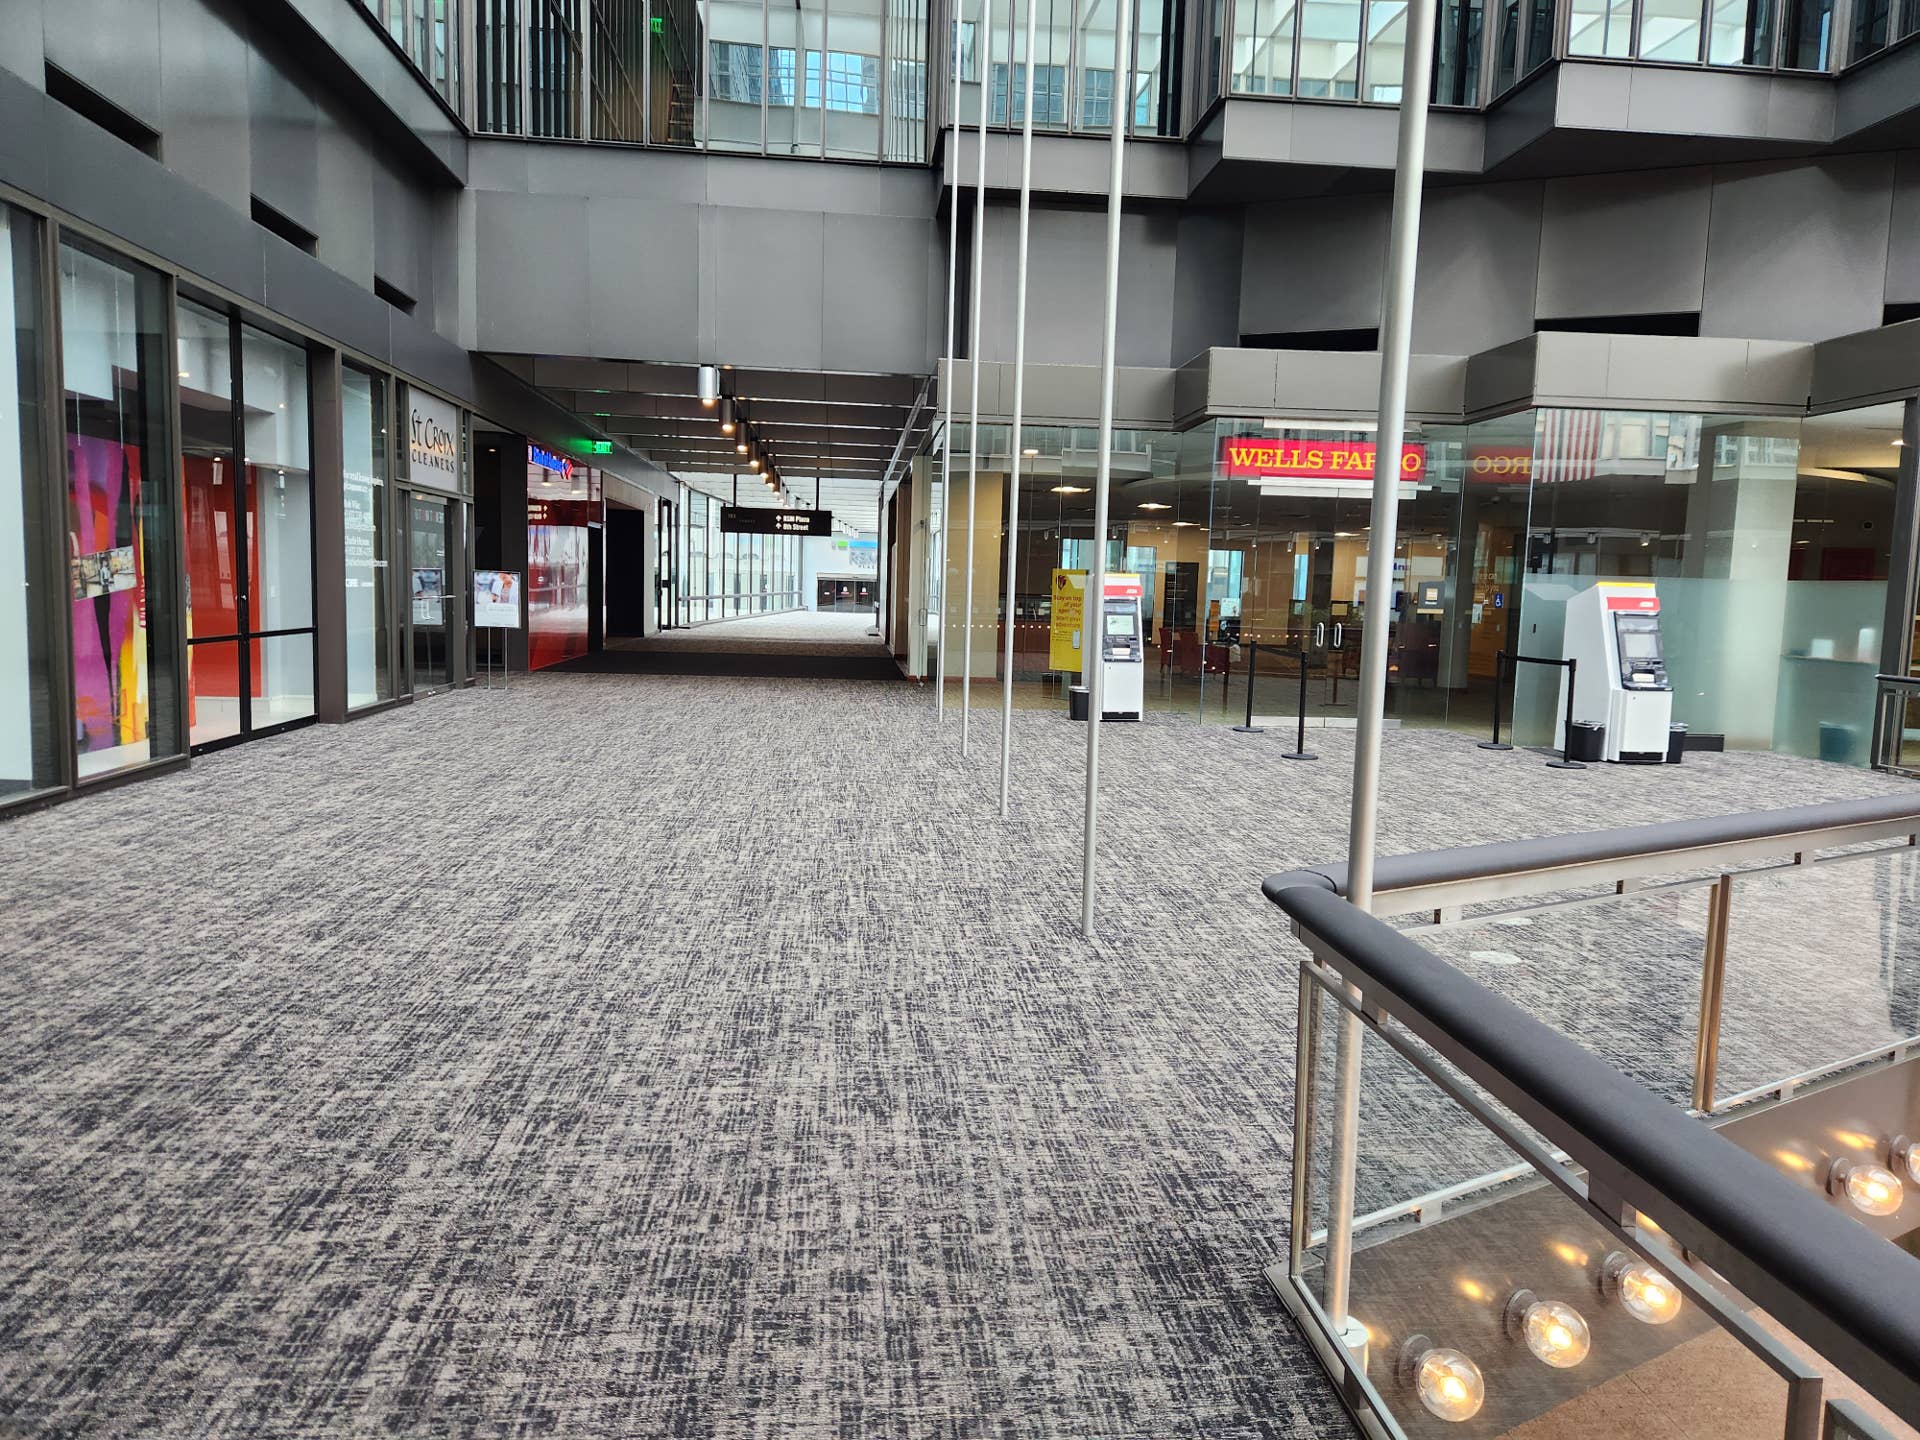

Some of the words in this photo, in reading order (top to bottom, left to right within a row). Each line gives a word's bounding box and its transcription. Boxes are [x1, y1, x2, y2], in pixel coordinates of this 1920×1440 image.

[411, 448, 455, 474] CLEANERS
[1229, 447, 1324, 470] WELLS
[1330, 451, 1421, 473] FAO
[792, 523, 809, 531] Street
